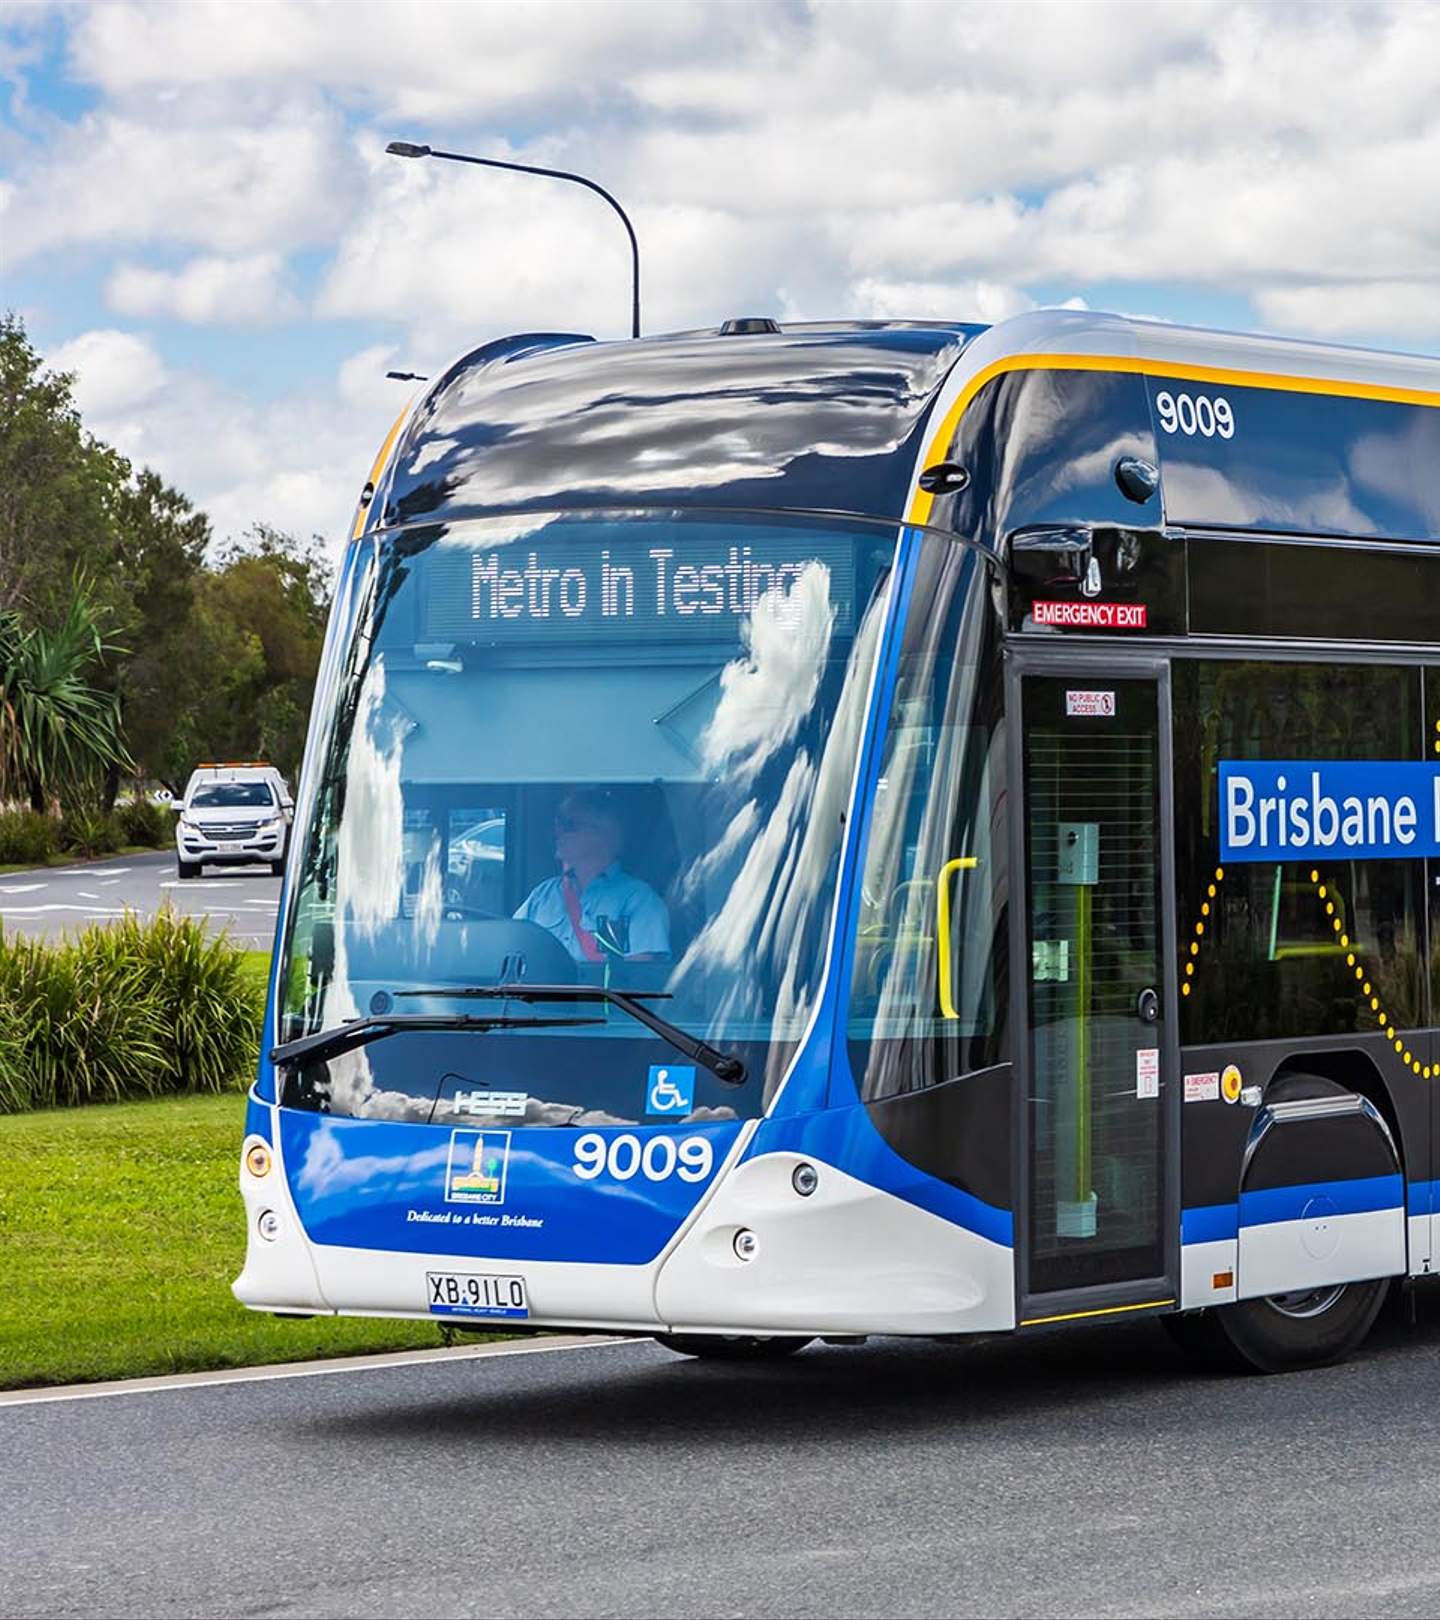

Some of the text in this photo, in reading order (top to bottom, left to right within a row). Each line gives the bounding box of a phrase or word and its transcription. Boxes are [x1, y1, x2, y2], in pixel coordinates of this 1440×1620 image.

[1156, 391, 1235, 439] 9009
[472, 547, 802, 630] Metro in Testing
[1033, 602, 1145, 625] EMERGENCY EXIT
[1227, 772, 1416, 848] Brisbane
[454, 1091, 528, 1116] HESS
[573, 1133, 713, 1183] 9009
[407, 1210, 451, 1223] Dedicated
[453, 1214, 462, 1224] to
[472, 1213, 499, 1225] better
[501, 1215, 544, 1228] Brisbane
